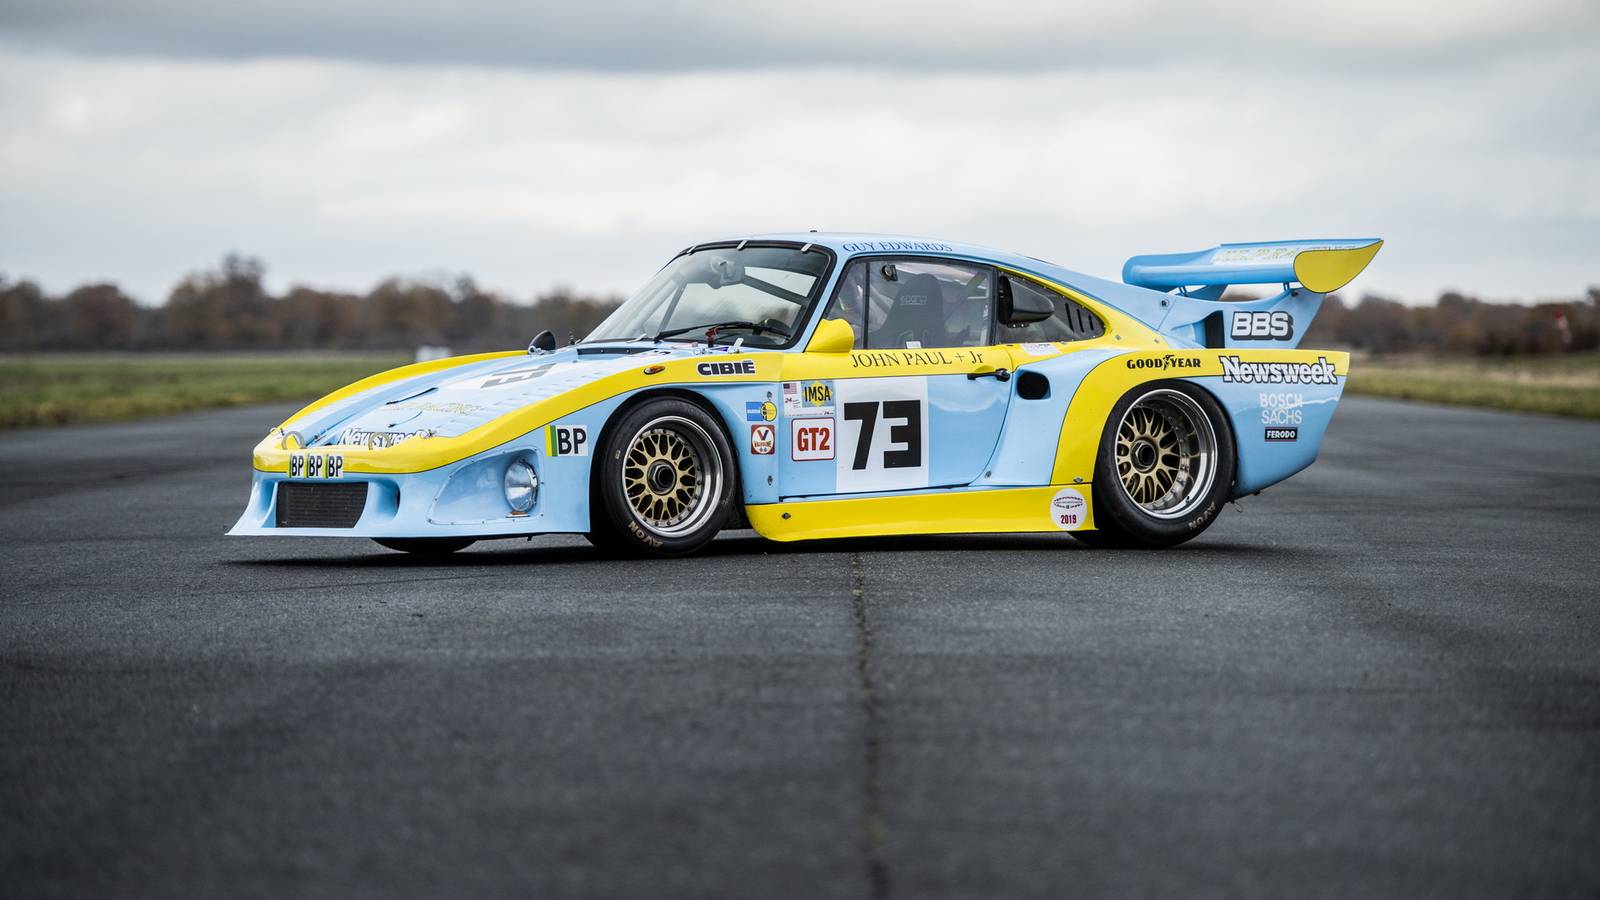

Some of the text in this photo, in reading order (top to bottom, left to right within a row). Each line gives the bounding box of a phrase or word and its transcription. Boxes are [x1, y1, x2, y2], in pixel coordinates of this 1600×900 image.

[842, 241, 953, 252] GUY EDWARDS
[1231, 311, 1292, 341] BBS
[852, 350, 984, 369] JOHN PAUL + Jr
[1218, 355, 1338, 385] Newsweek
[803, 385, 832, 402] IMSA
[1259, 393, 1303, 408] BOSCH
[1261, 409, 1303, 424] SACHS
[556, 428, 588, 455] BP
[797, 427, 831, 452] GT2
[844, 400, 922, 470] 73
[1266, 430, 1296, 439] FERODO
[291, 455, 305, 477] BP
[308, 455, 323, 477] BP
[328, 455, 343, 477] BP
[1060, 514, 1077, 525] 2019
[628, 520, 663, 548] AVON
